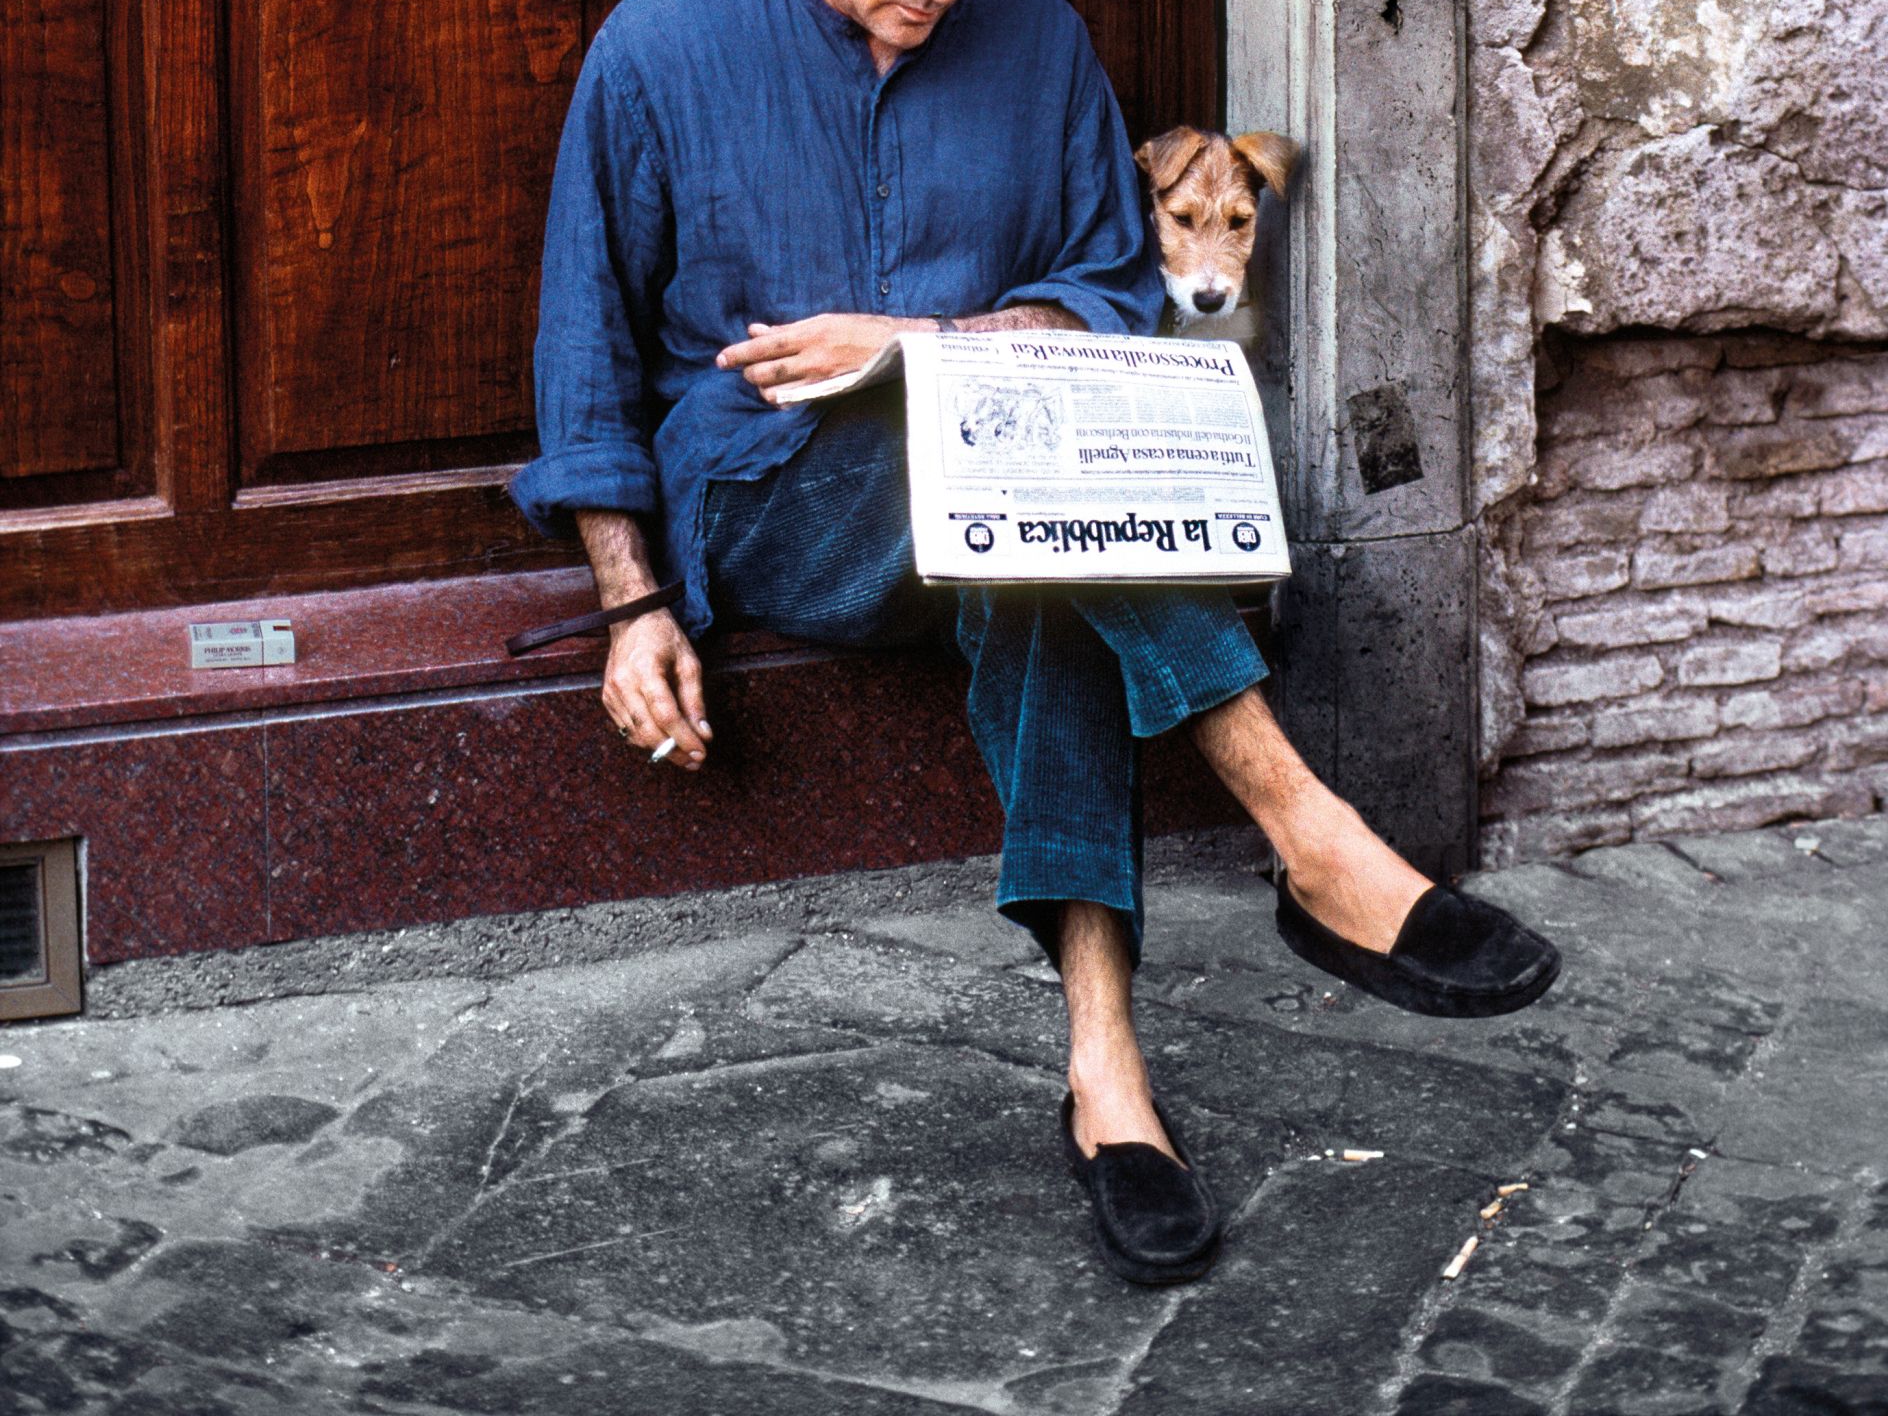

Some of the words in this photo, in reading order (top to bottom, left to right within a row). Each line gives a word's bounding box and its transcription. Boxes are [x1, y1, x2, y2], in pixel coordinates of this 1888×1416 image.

[1010, 342, 1048, 361] Rai
[1048, 344, 1108, 361] nuova
[1112, 348, 1145, 368] alla
[1148, 351, 1235, 378] Processo
[1075, 427, 1129, 440] Berlusconi
[1130, 428, 1149, 438] con
[1212, 431, 1242, 444] Gotha
[1243, 434, 1251, 444] Il
[1078, 444, 1130, 464] Agnelli
[1132, 448, 1164, 460] casa
[1166, 448, 1174, 460] a
[1176, 448, 1208, 460] cena
[1211, 450, 1218, 460] a
[1220, 451, 1256, 468] Tutti
[1018, 512, 1178, 552] Repubblica
[1182, 520, 1212, 552] la
